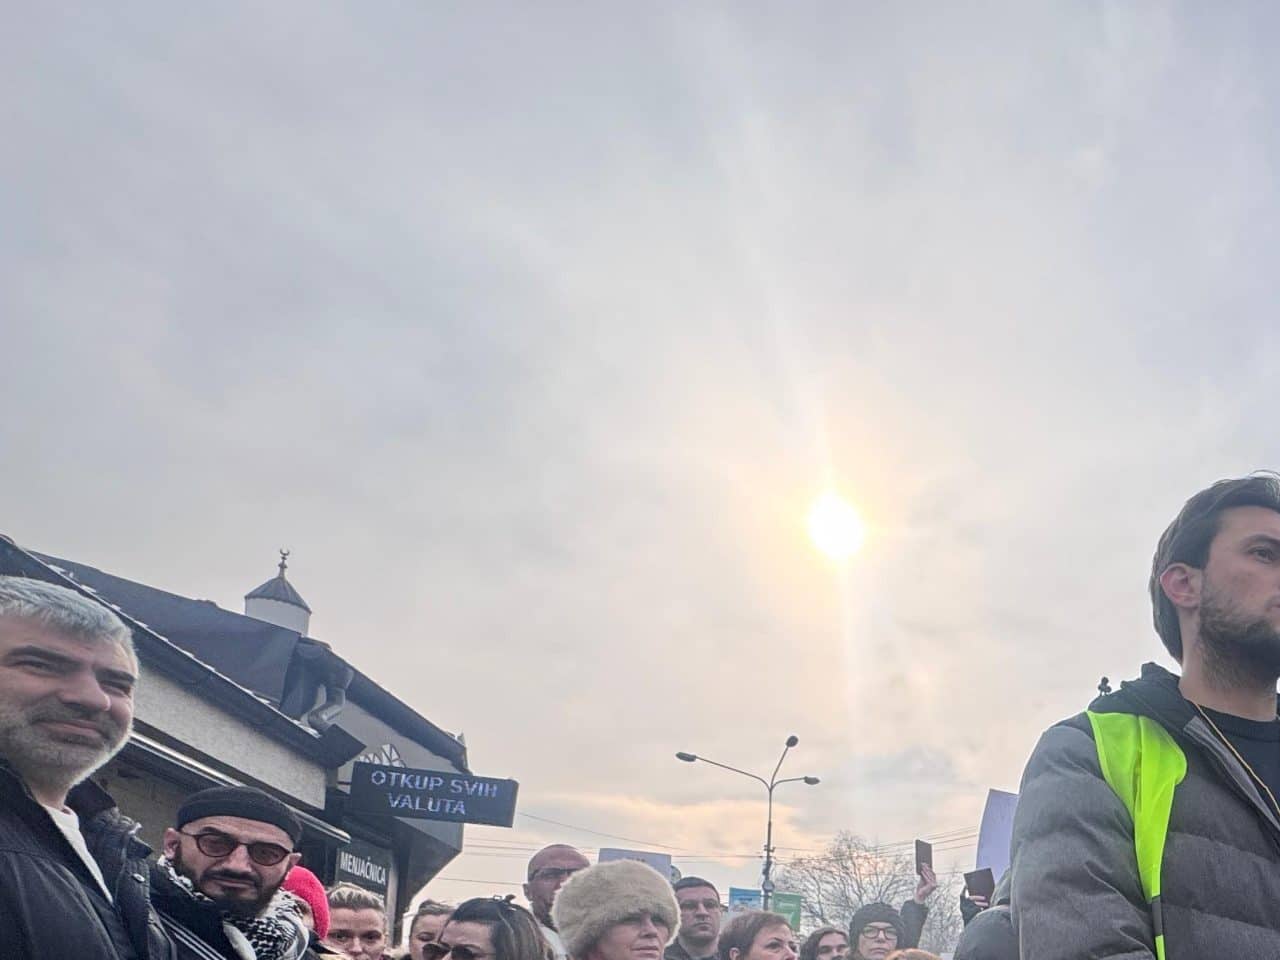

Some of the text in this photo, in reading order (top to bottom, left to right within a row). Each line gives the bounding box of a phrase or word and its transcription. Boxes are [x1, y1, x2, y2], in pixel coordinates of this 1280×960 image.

[371, 770, 498, 798] OTKUP SVIH
[387, 793, 466, 815] VALUTA
[340, 851, 386, 886] MENJAČNICA
